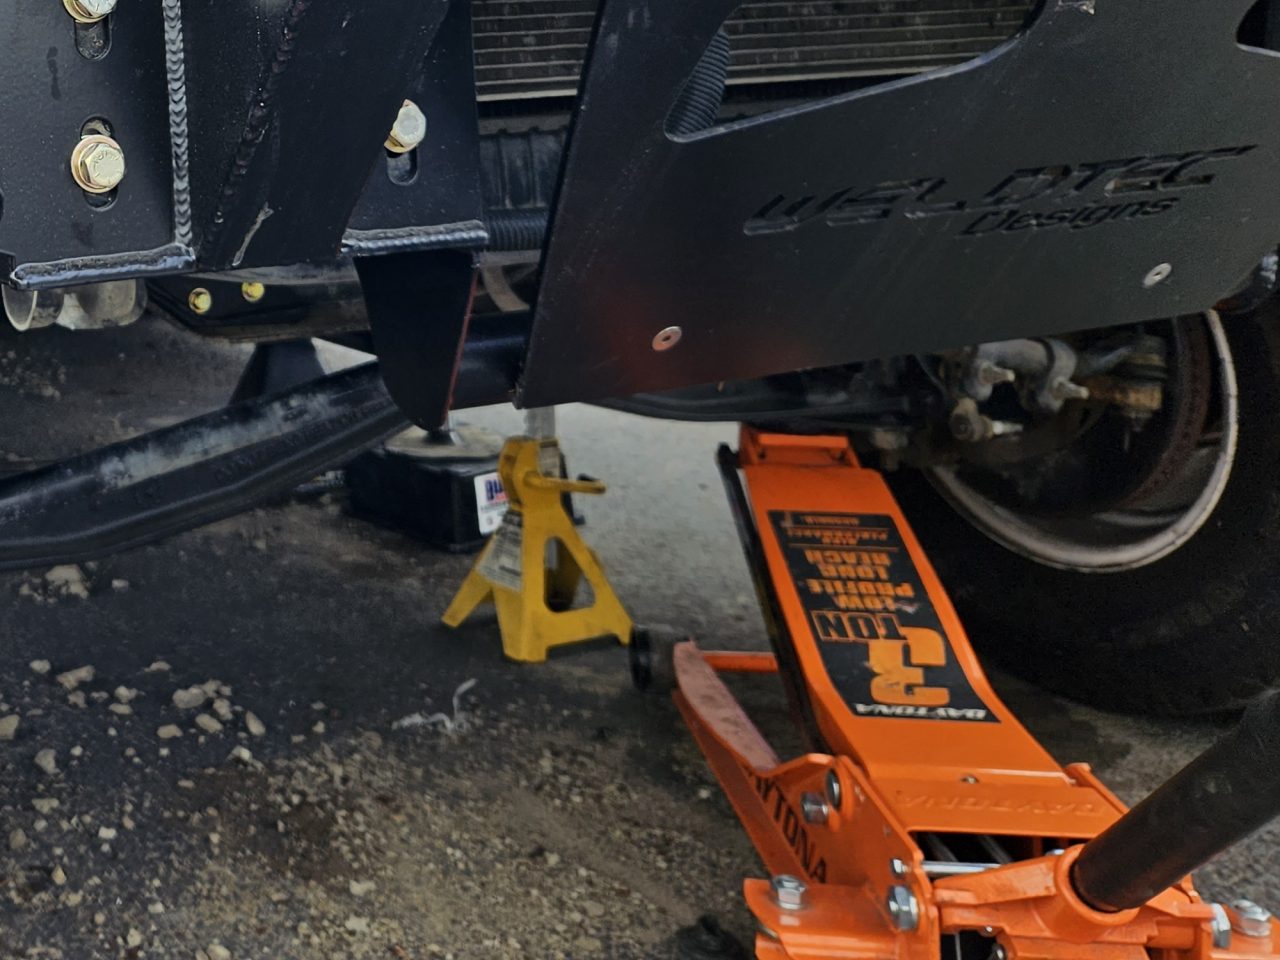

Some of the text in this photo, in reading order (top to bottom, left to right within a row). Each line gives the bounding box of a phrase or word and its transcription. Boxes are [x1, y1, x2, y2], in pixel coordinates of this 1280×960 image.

[804, 549, 891, 567] REACH
[817, 564, 889, 580] LONG
[806, 579, 915, 598] PROFILE
[832, 594, 896, 611] LOW
[811, 610, 909, 642] TON
[869, 626, 951, 707] 3
[854, 703, 987, 720] DAYTONA
